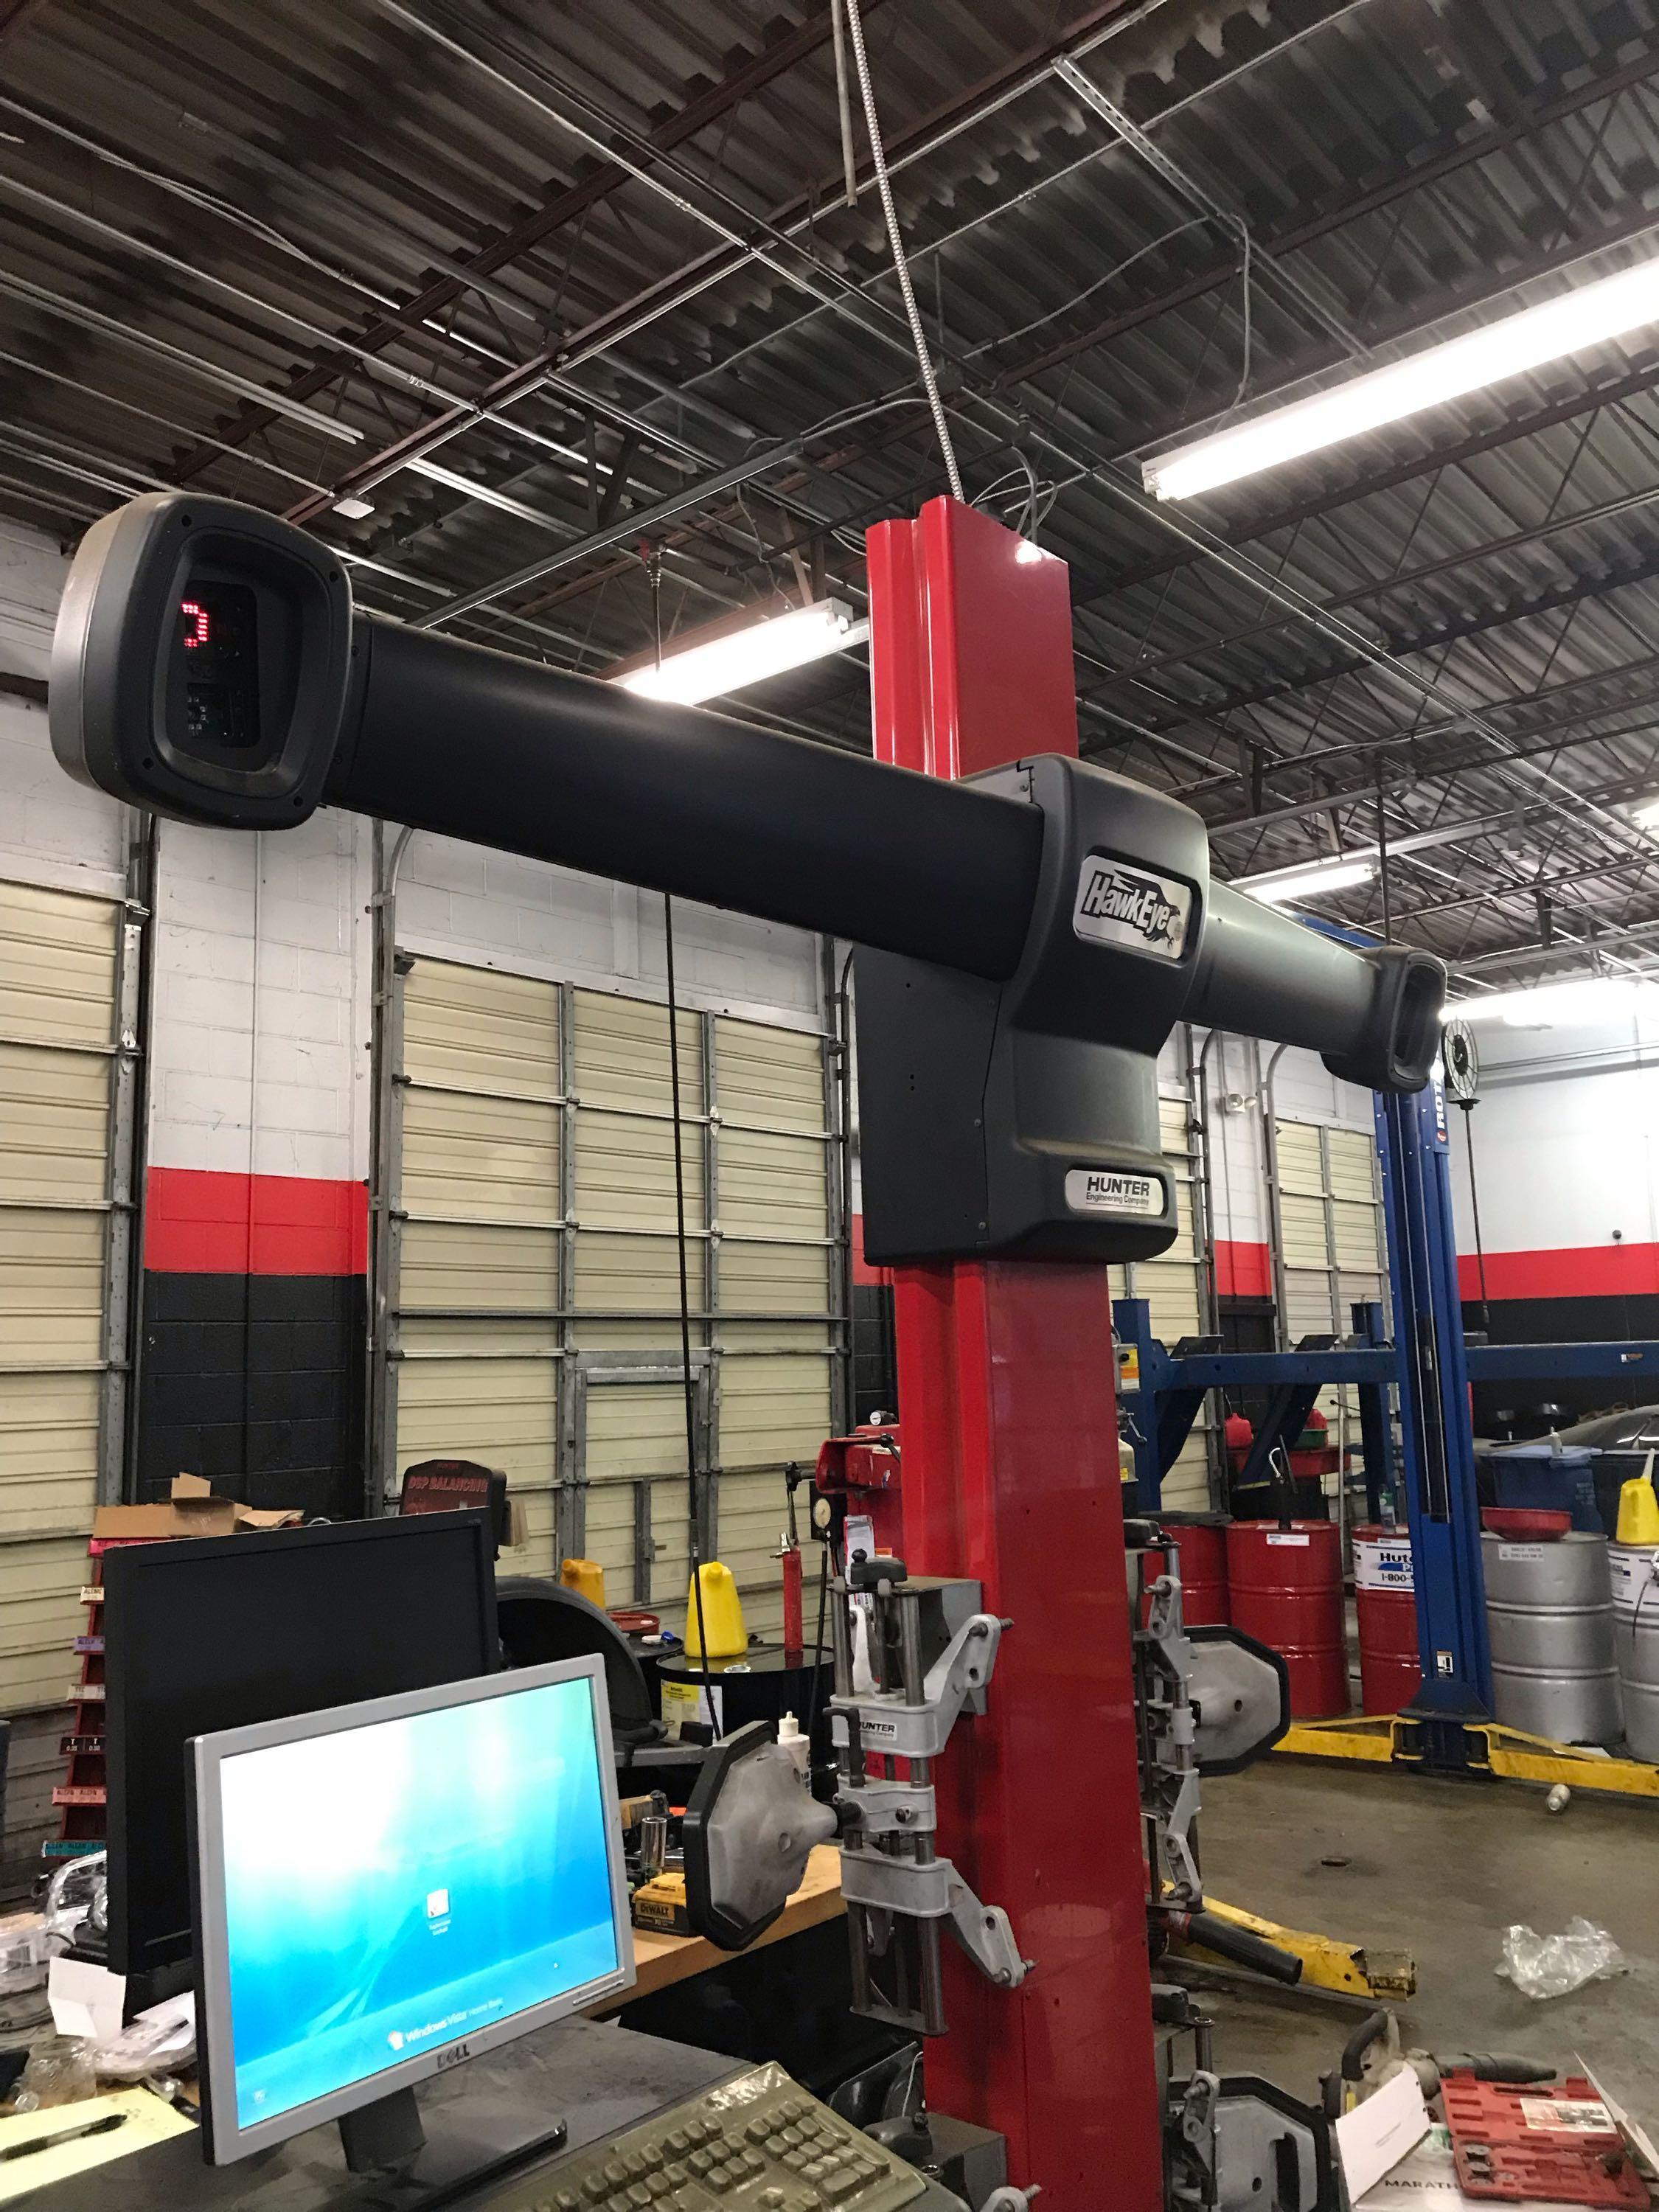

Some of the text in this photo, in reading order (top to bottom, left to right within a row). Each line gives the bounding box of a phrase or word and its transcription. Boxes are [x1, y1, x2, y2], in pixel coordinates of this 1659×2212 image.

[1082, 873, 1171, 934] HawkEye
[1087, 1176, 1150, 1196] HUNTER
[1086, 1192, 1150, 1206] Engineering Company
[860, 1722, 895, 1733] UNTER
[406, 2019, 448, 2042] Windows
